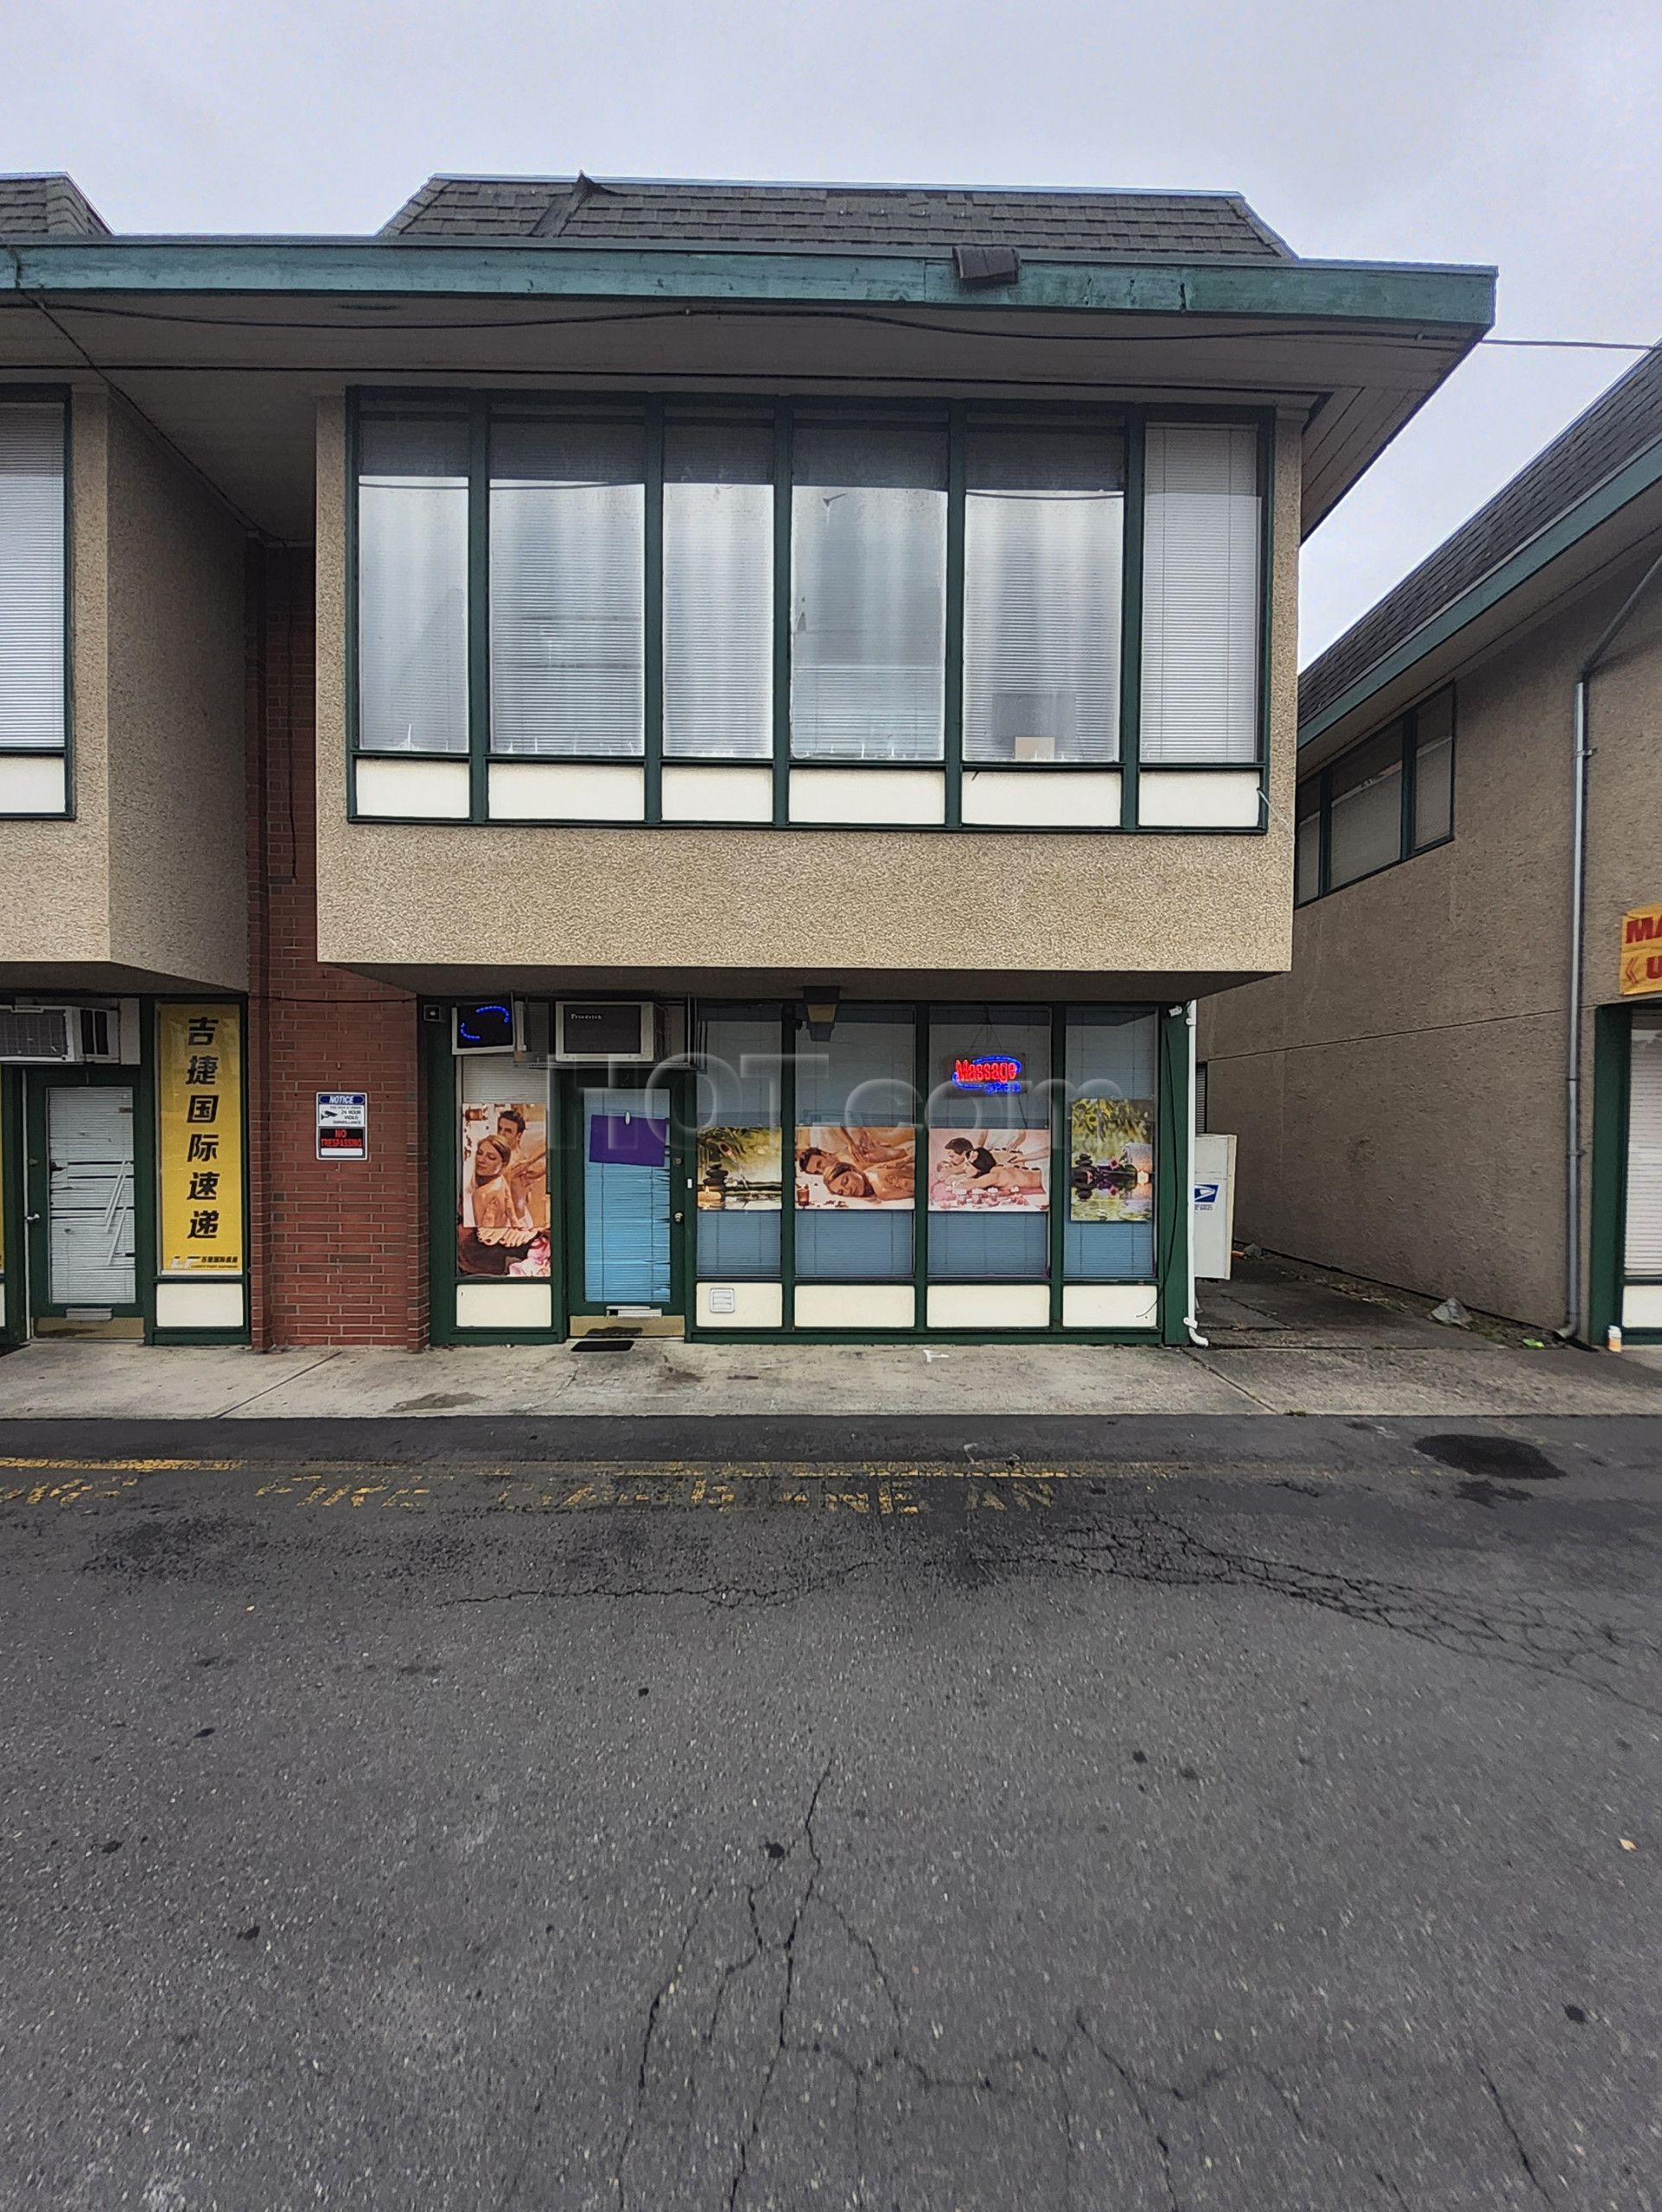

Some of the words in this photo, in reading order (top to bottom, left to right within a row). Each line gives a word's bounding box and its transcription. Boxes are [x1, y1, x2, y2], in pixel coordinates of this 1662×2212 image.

[1626, 915, 1662, 944] M
[955, 1059, 1017, 1084] Massage
[329, 1095, 354, 1104] NOTICE
[186, 1016, 220, 1239] 吉捷国际速递
[334, 1129, 347, 1138] NO
[321, 1138, 362, 1147] TRESPASSING
